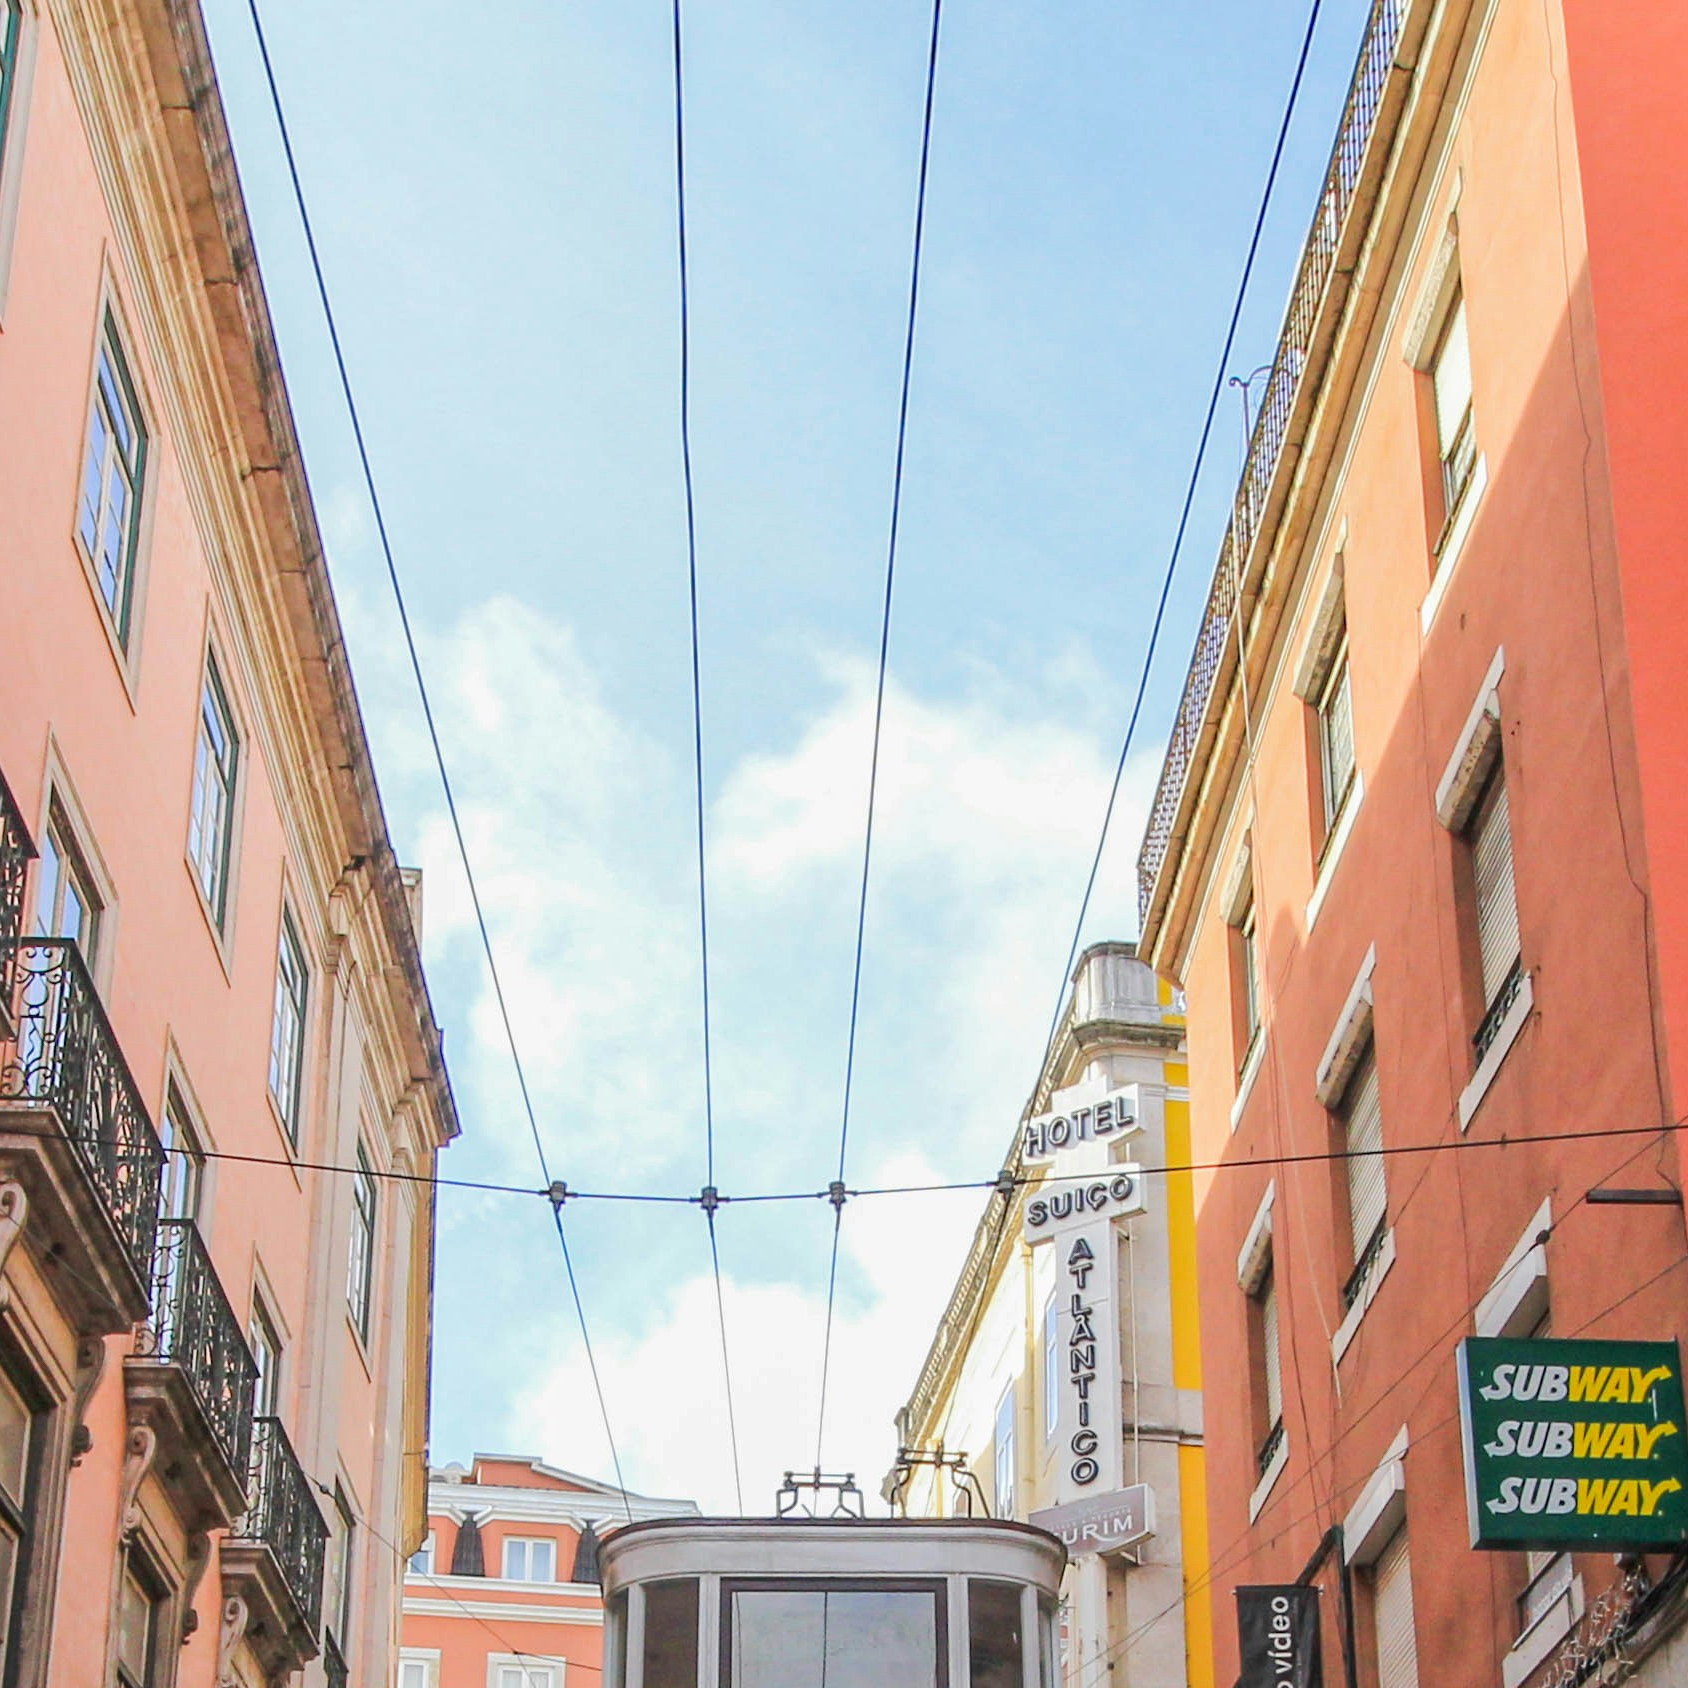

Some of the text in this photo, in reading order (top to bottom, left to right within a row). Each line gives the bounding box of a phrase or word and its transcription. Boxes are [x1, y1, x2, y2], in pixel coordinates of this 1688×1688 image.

[1024, 1096, 1134, 1157] HOTEL
[1479, 1364, 1672, 1404] SUBWAY
[1484, 1420, 1678, 1460] SUBWAY
[1486, 1476, 1682, 1517] SUBWAY
[1053, 1514, 1133, 1545] URIM
[1267, 1596, 1293, 1675] vídeo
